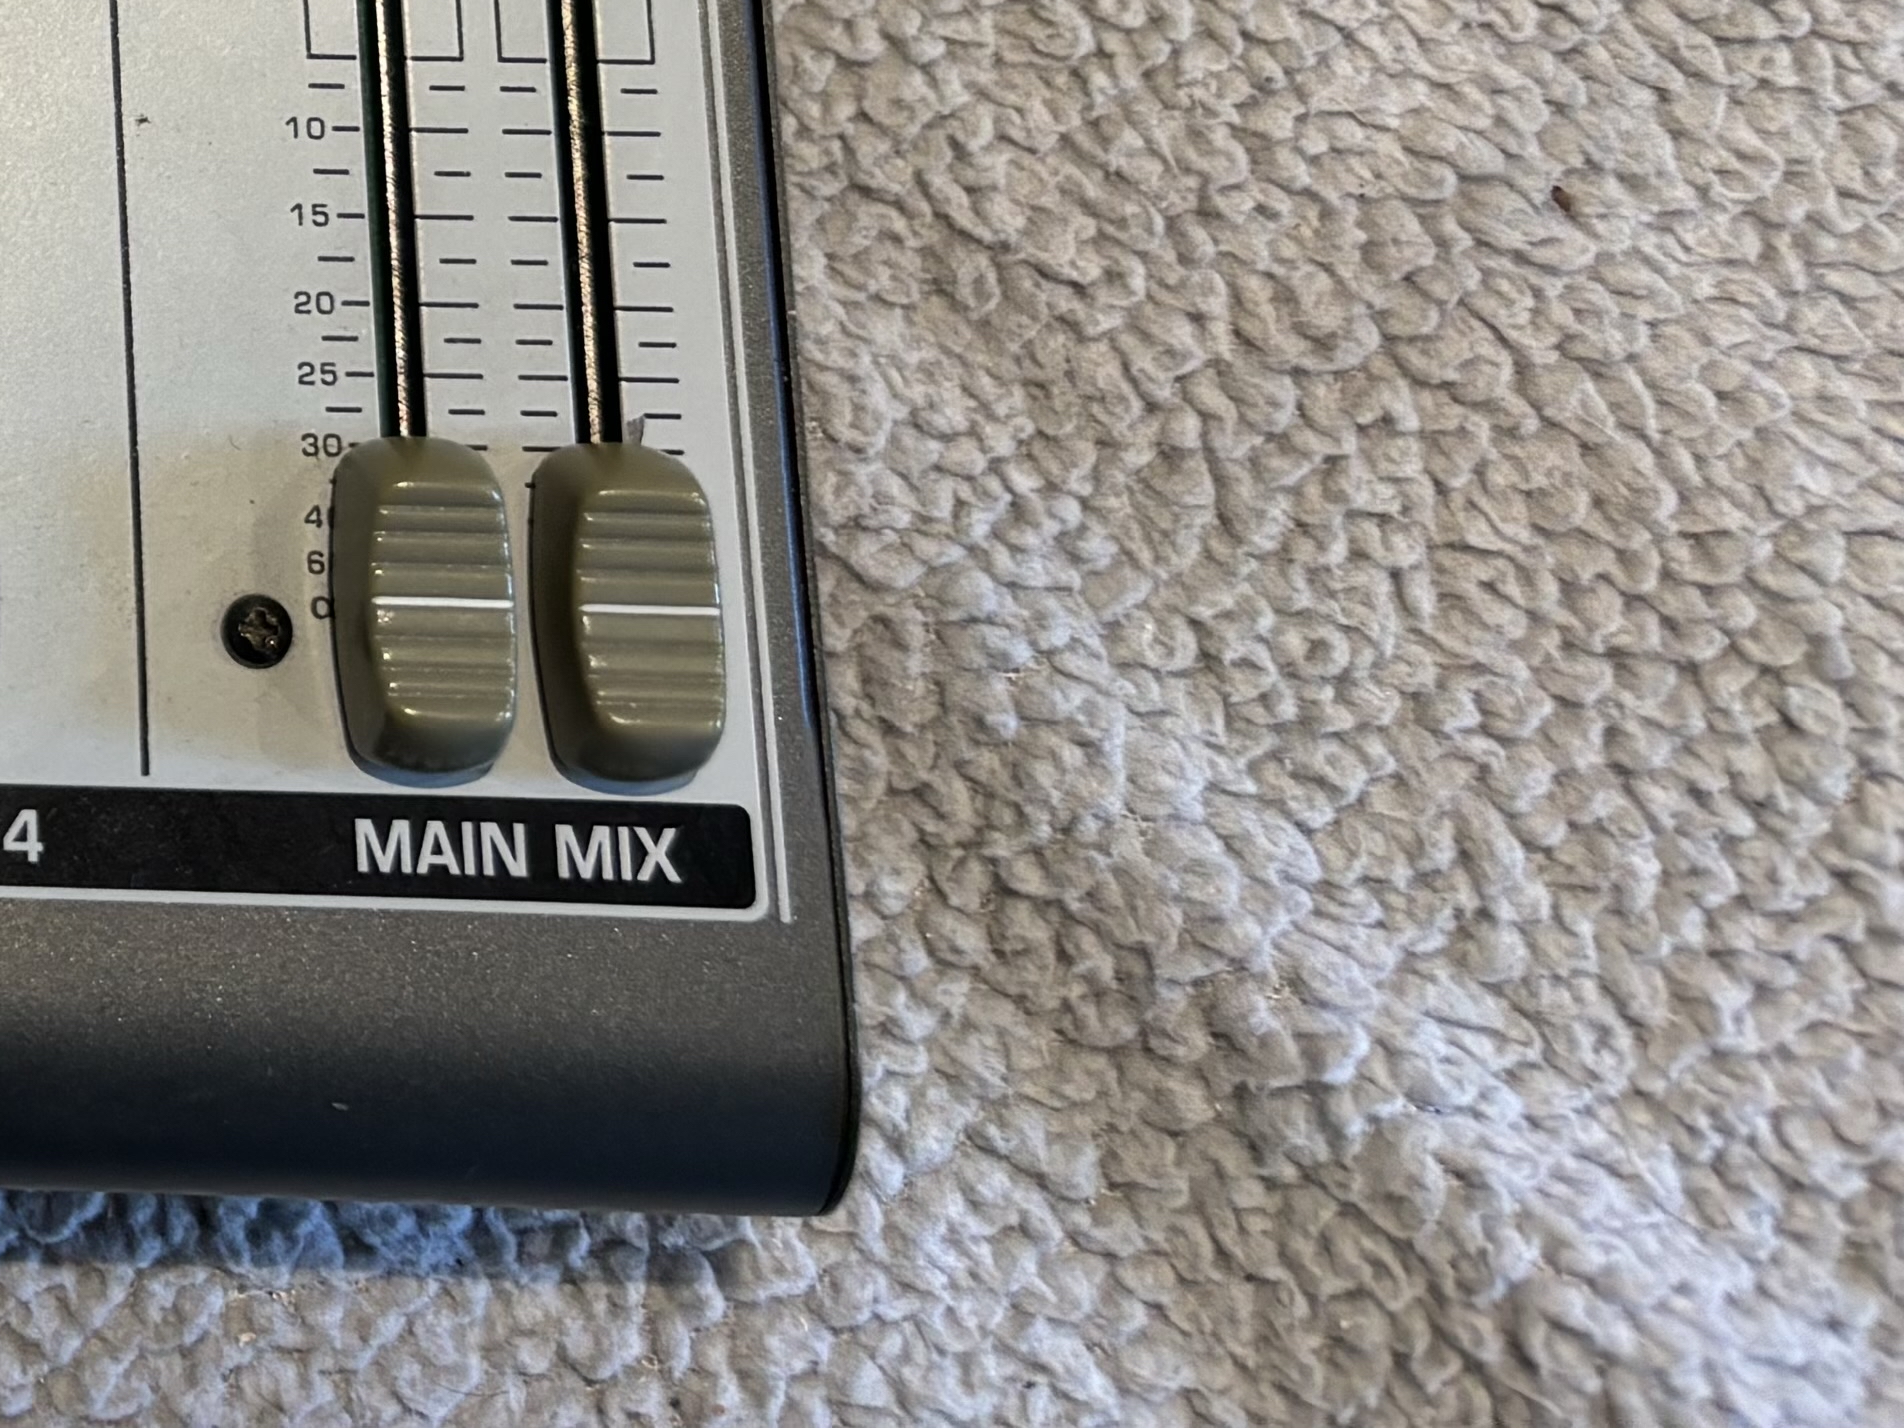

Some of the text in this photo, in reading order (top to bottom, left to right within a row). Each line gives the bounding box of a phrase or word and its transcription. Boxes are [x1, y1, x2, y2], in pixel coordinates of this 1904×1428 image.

[289, 203, 329, 226] 15
[292, 292, 335, 315] 20
[297, 363, 338, 385] 25
[355, 818, 681, 882] MAIN MIX
